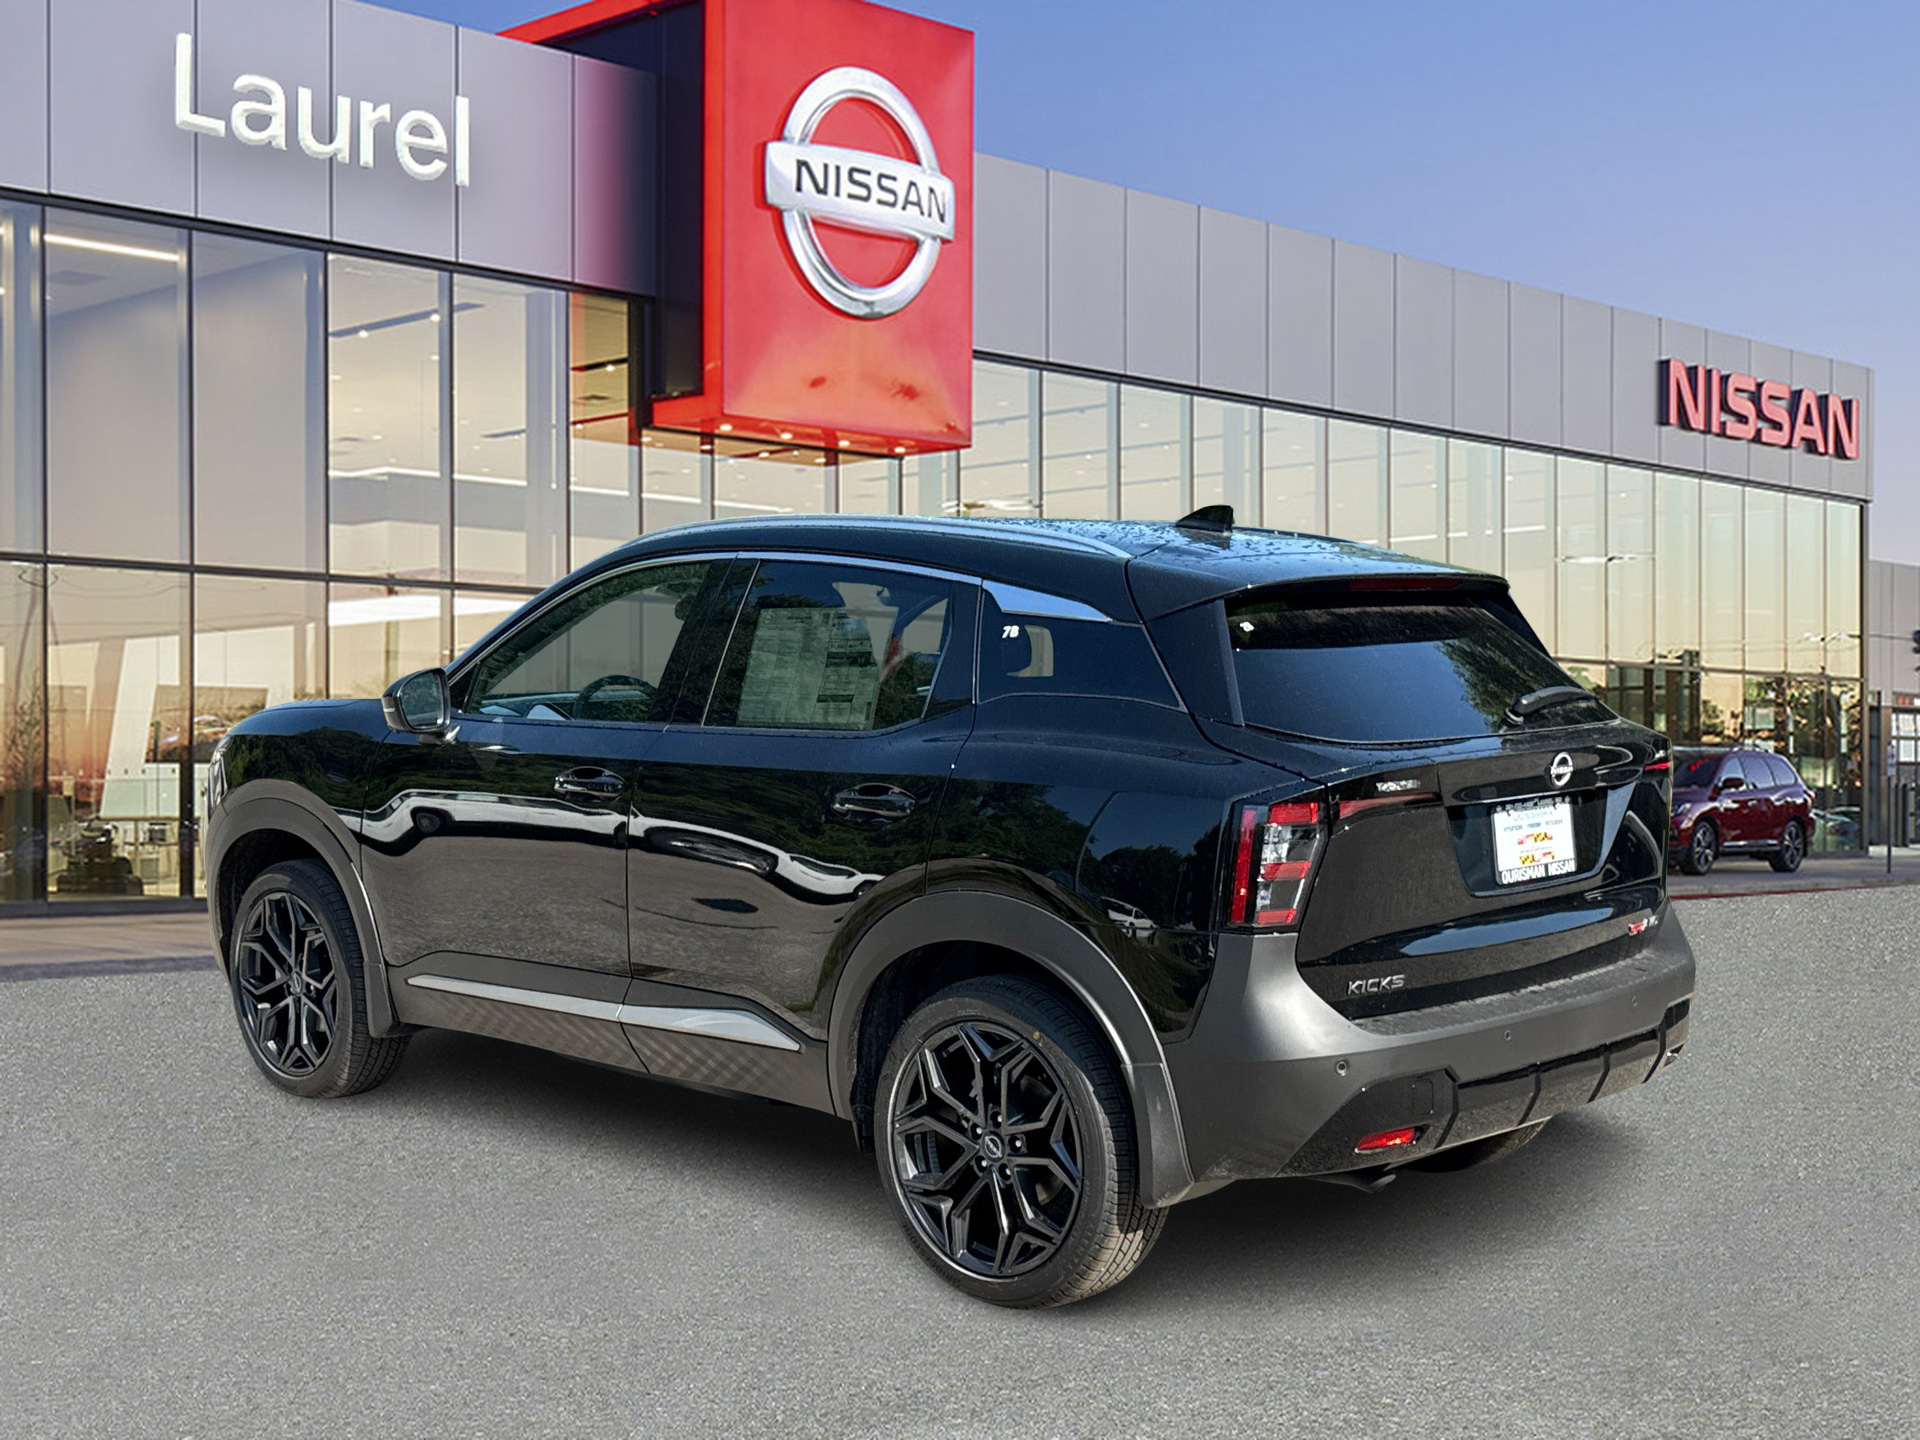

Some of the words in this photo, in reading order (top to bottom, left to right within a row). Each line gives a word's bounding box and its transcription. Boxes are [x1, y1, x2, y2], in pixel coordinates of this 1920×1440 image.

[174, 33, 470, 187] Laurel
[794, 159, 946, 223] NISSAN
[1662, 358, 1860, 460] NISSAN
[1501, 864, 1546, 885] OURISMAN
[1548, 859, 1576, 876] NISSAN
[1347, 974, 1405, 995] KICKS
